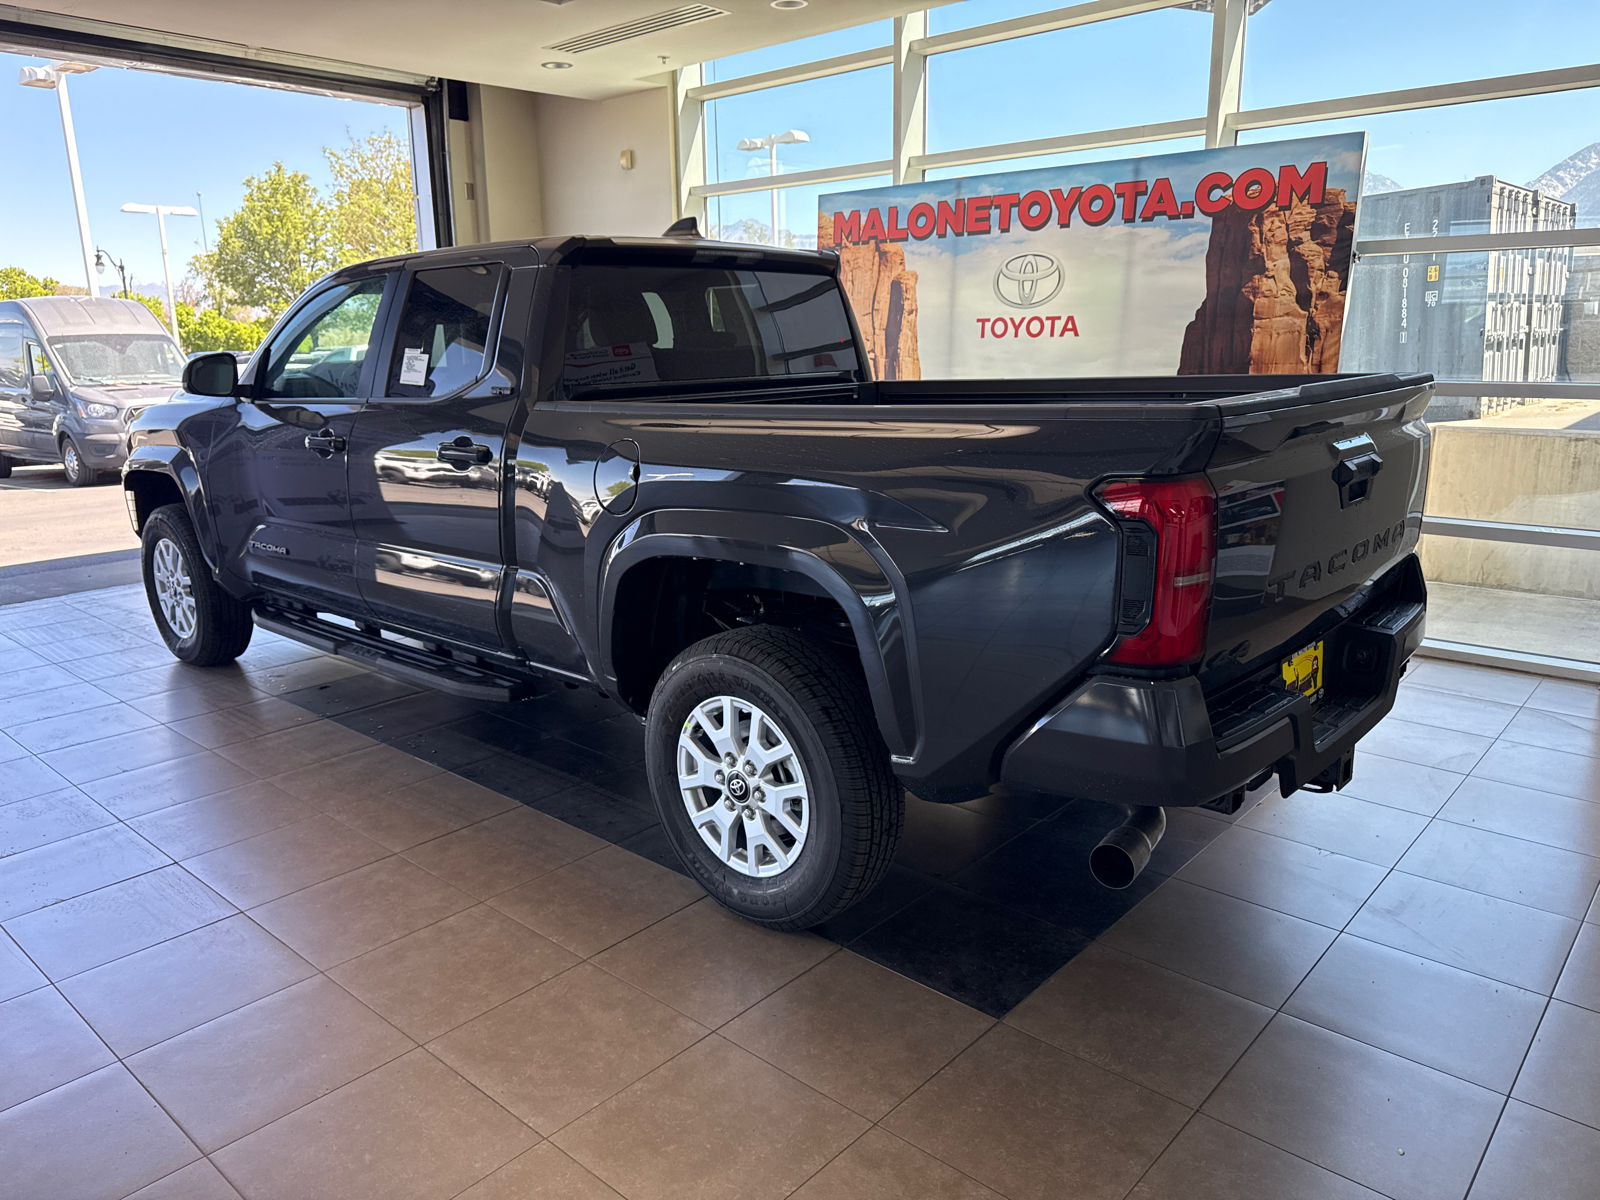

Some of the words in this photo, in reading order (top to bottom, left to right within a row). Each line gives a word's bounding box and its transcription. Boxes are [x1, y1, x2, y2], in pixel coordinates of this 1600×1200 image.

[833, 161, 1328, 245] MALONETOYOTA.COM
[976, 315, 1080, 339] TOYOTA
[248, 540, 287, 555] TACOMA
[1267, 520, 1405, 602] TACOMA
